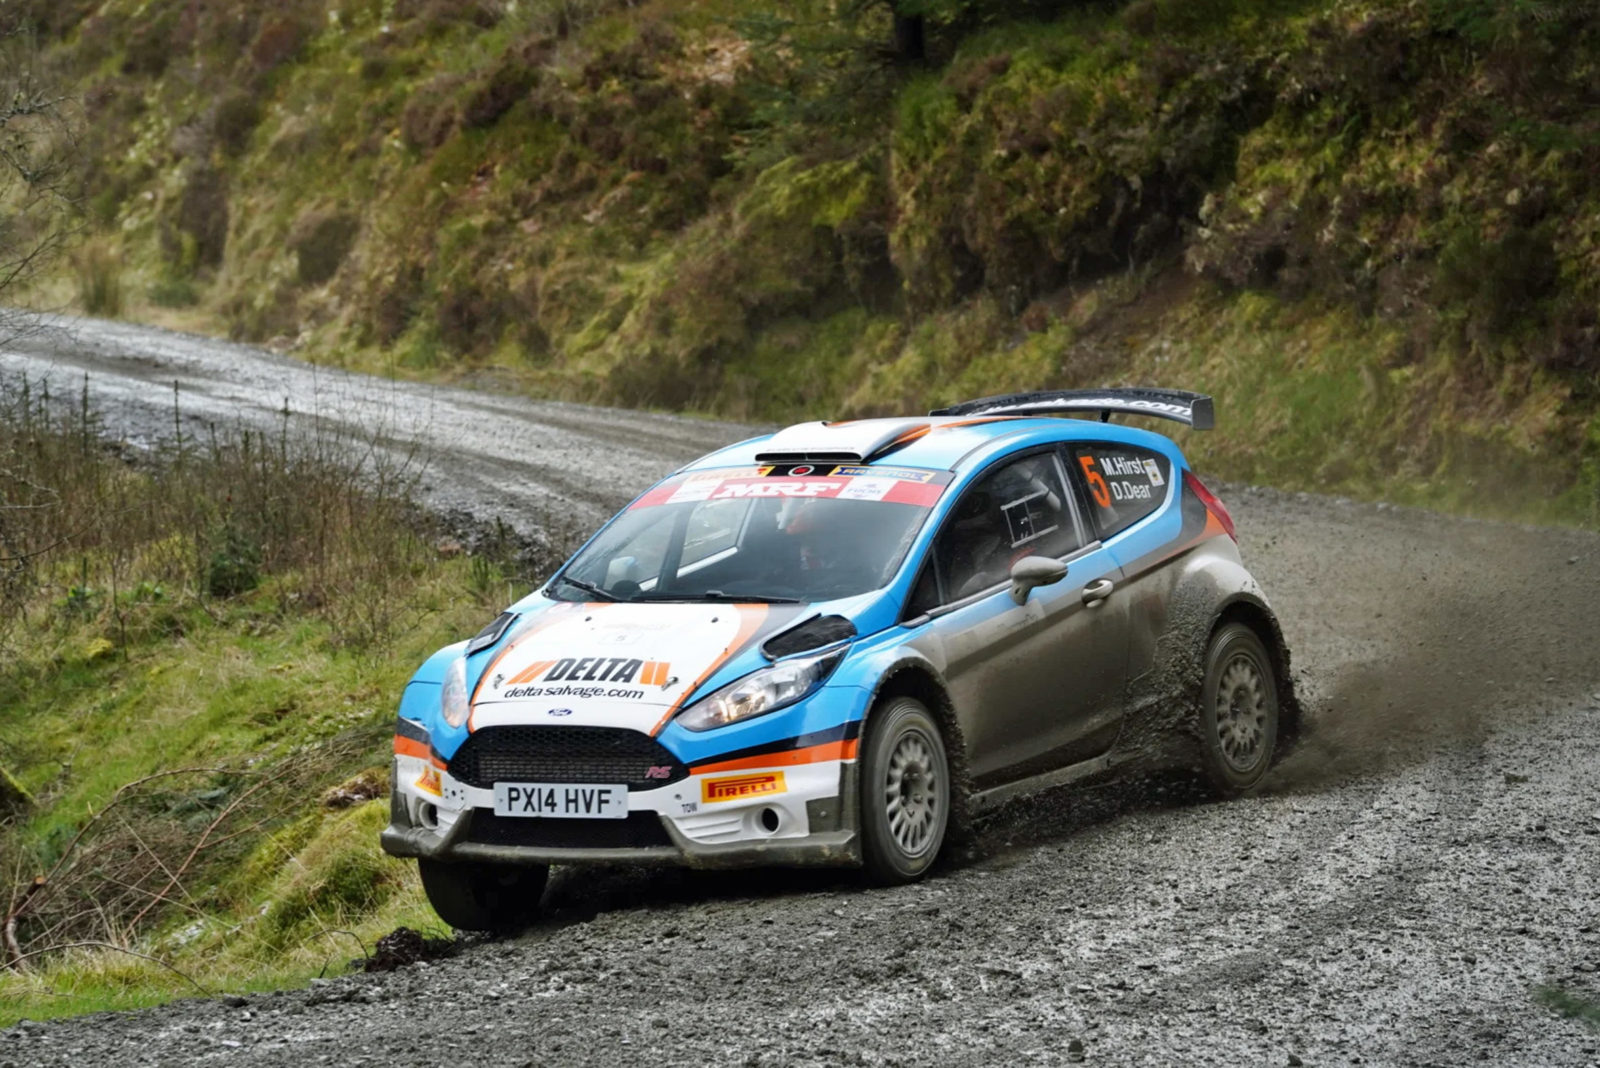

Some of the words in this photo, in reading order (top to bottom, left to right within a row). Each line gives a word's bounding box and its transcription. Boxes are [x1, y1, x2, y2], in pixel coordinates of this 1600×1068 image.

[1100, 457, 1146, 476] M.Hirst
[711, 482, 842, 499] MRF
[1078, 456, 1111, 508] 5
[1110, 481, 1151, 500] D.Dear
[543, 657, 643, 683] DELTA
[645, 766, 672, 779] RS
[708, 776, 776, 799] PIRELLI
[508, 787, 557, 812] PX14
[565, 788, 612, 814] HVF
